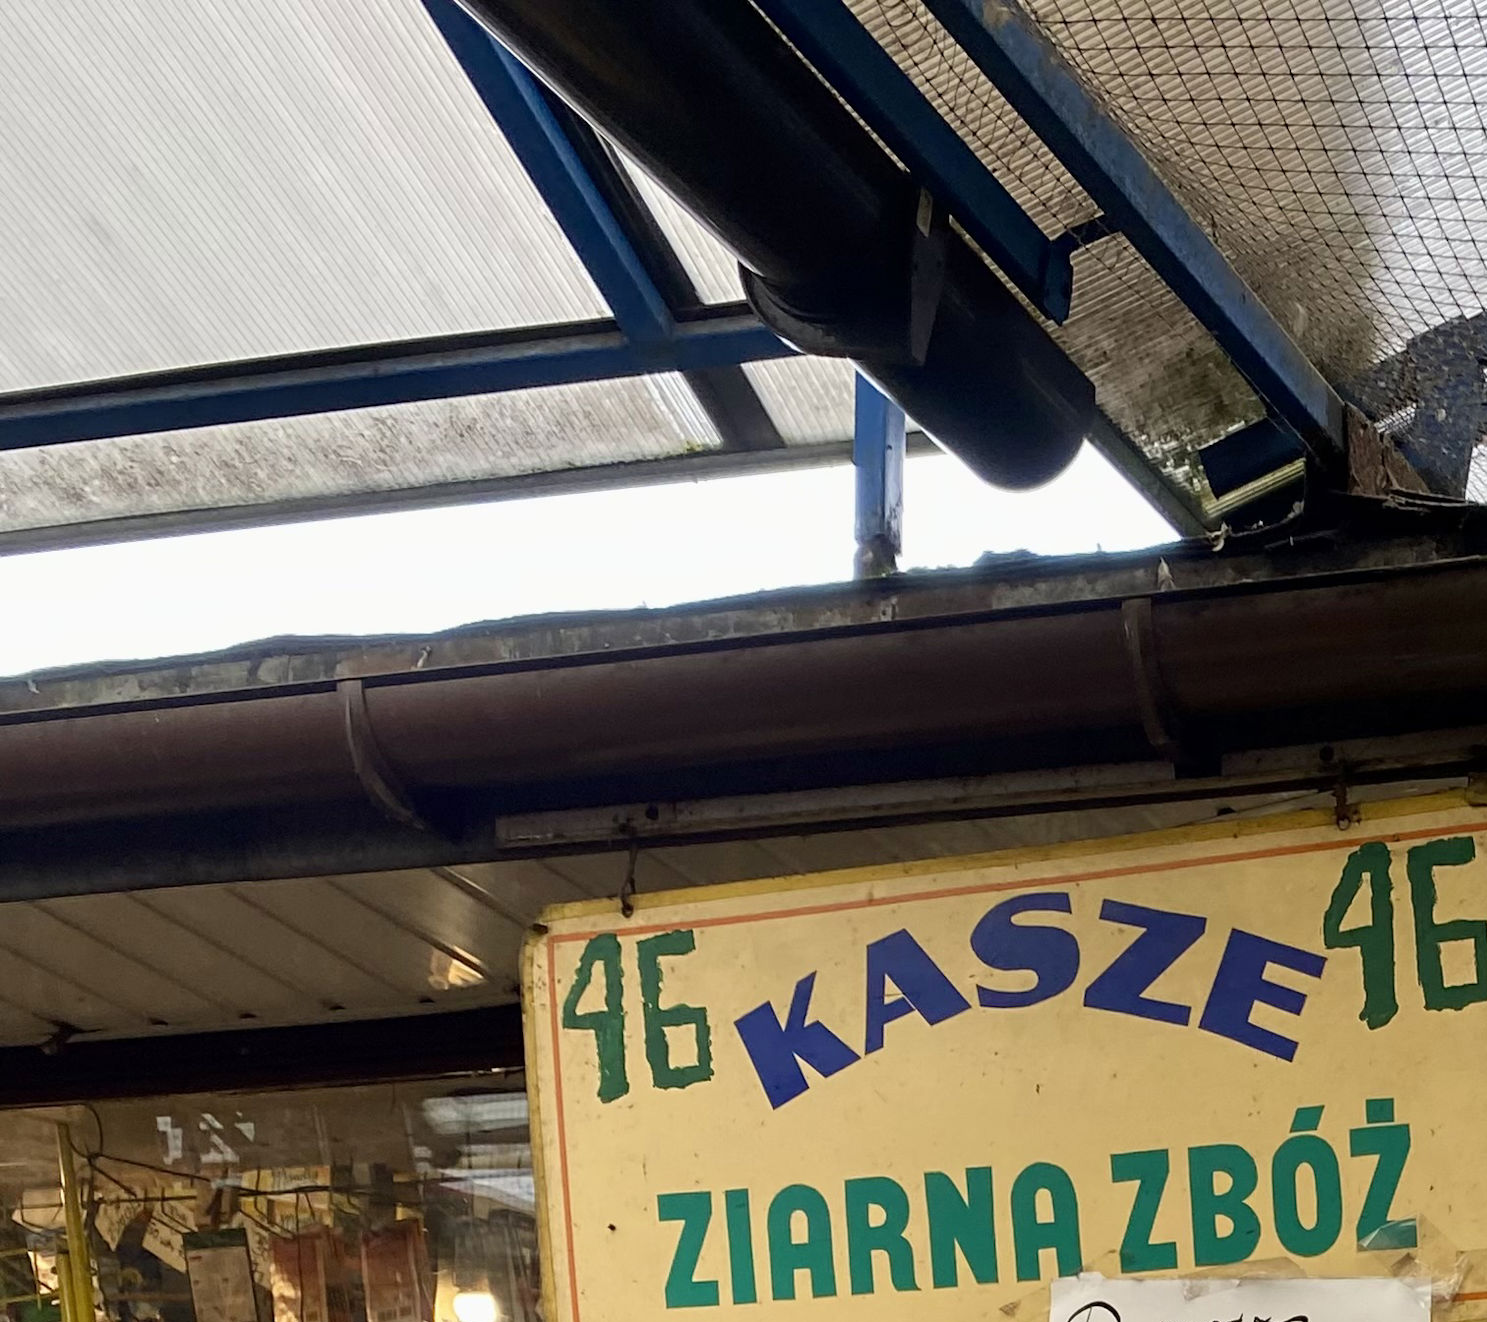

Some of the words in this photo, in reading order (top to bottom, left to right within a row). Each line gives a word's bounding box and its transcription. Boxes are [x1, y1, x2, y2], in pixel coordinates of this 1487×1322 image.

[562, 929, 712, 1104] 46
[735, 892, 1328, 1109] KASZE
[657, 1161, 1083, 1308] ZIARNA
[1110, 1098, 1418, 1274] ZBÓŻ
